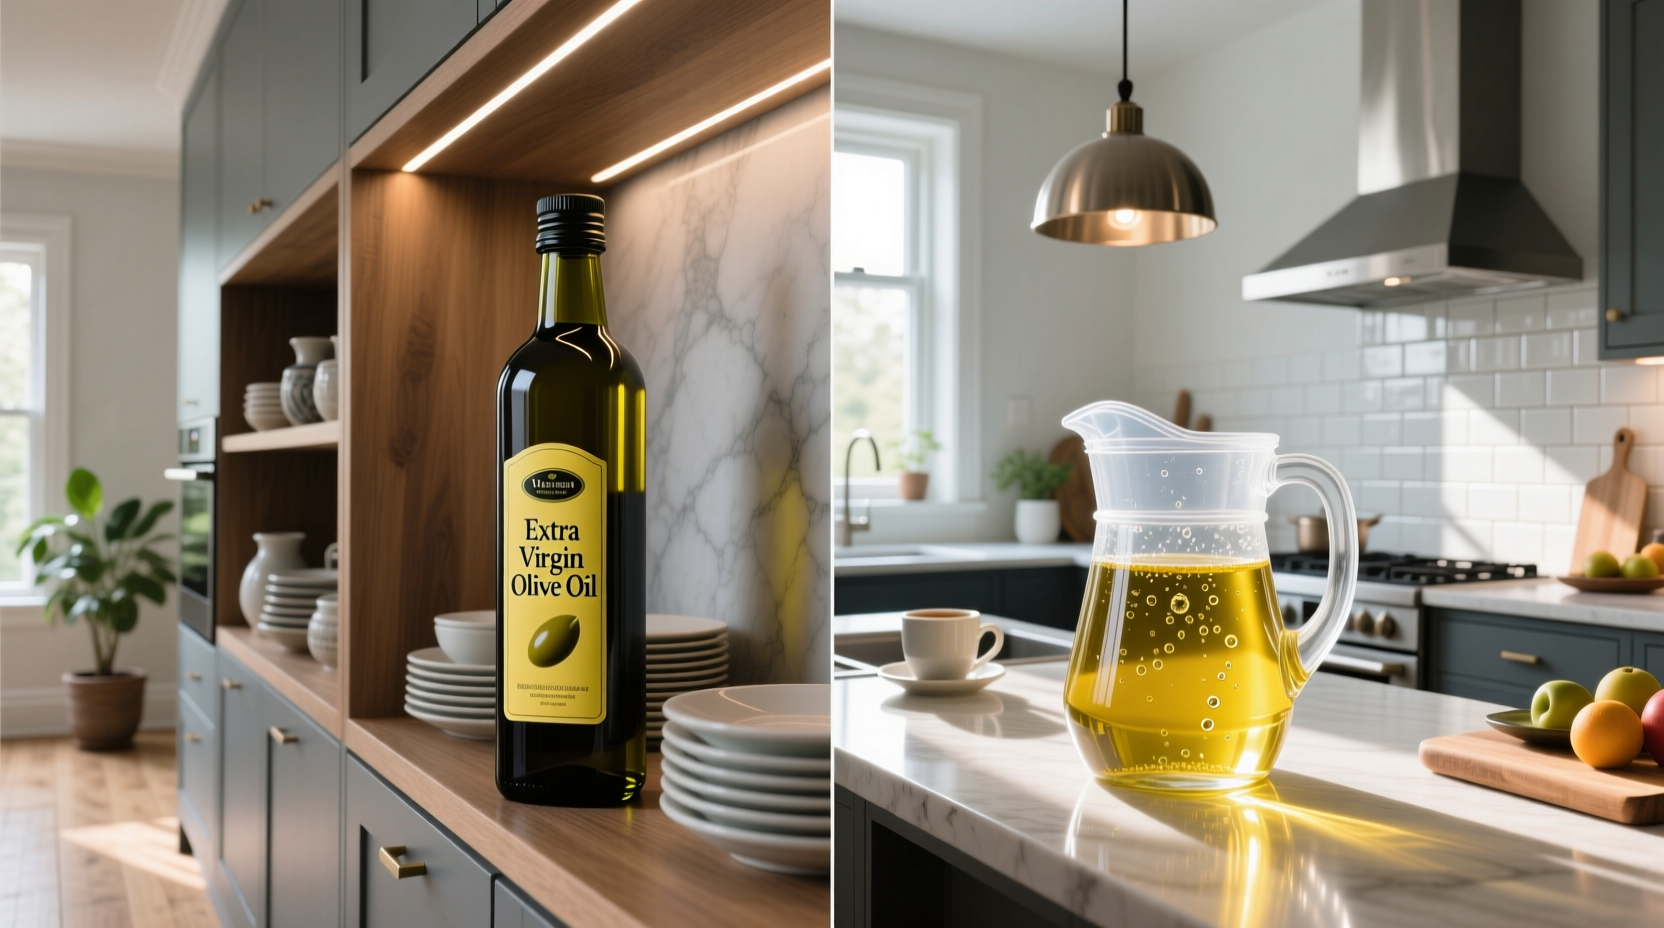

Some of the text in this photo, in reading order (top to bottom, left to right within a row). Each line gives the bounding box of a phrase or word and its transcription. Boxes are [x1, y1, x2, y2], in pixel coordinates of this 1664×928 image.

[524, 518, 580, 541] Extra
[519, 546, 584, 576] Virgin
[511, 573, 598, 598] Olive Oil
